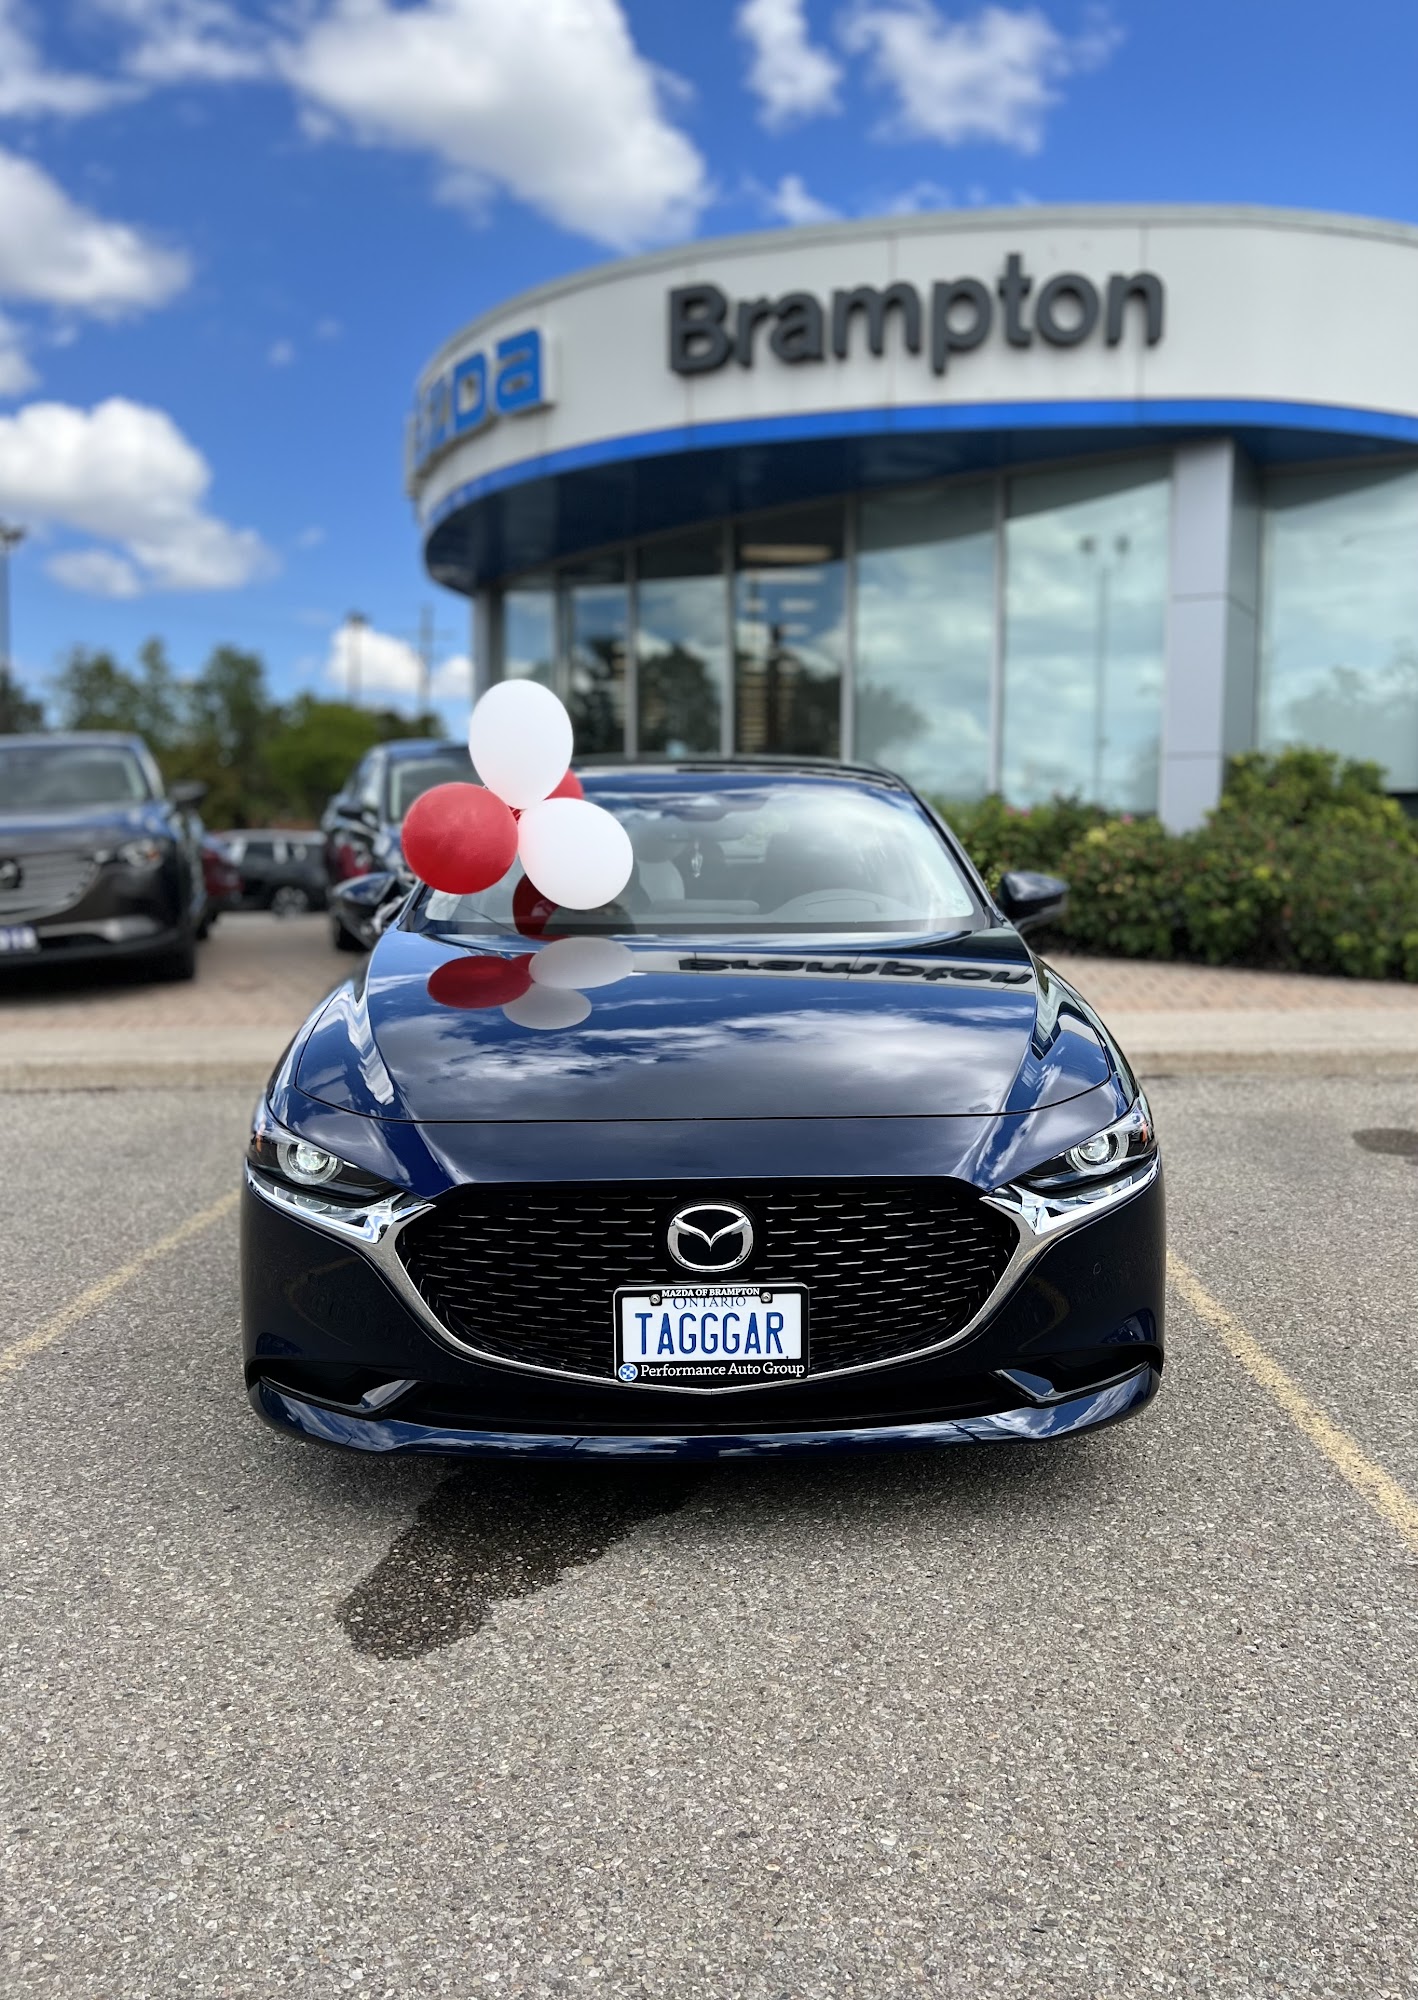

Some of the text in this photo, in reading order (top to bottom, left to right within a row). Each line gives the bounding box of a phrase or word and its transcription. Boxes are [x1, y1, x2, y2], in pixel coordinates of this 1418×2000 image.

[667, 253, 1166, 376] Brampton
[661, 1287, 760, 1297] MAZDA OF BRAMPTON
[672, 1296, 746, 1310] ONTARIO
[635, 1312, 784, 1354] TAGGGAR
[640, 1362, 805, 1377] Performance Auto Group
